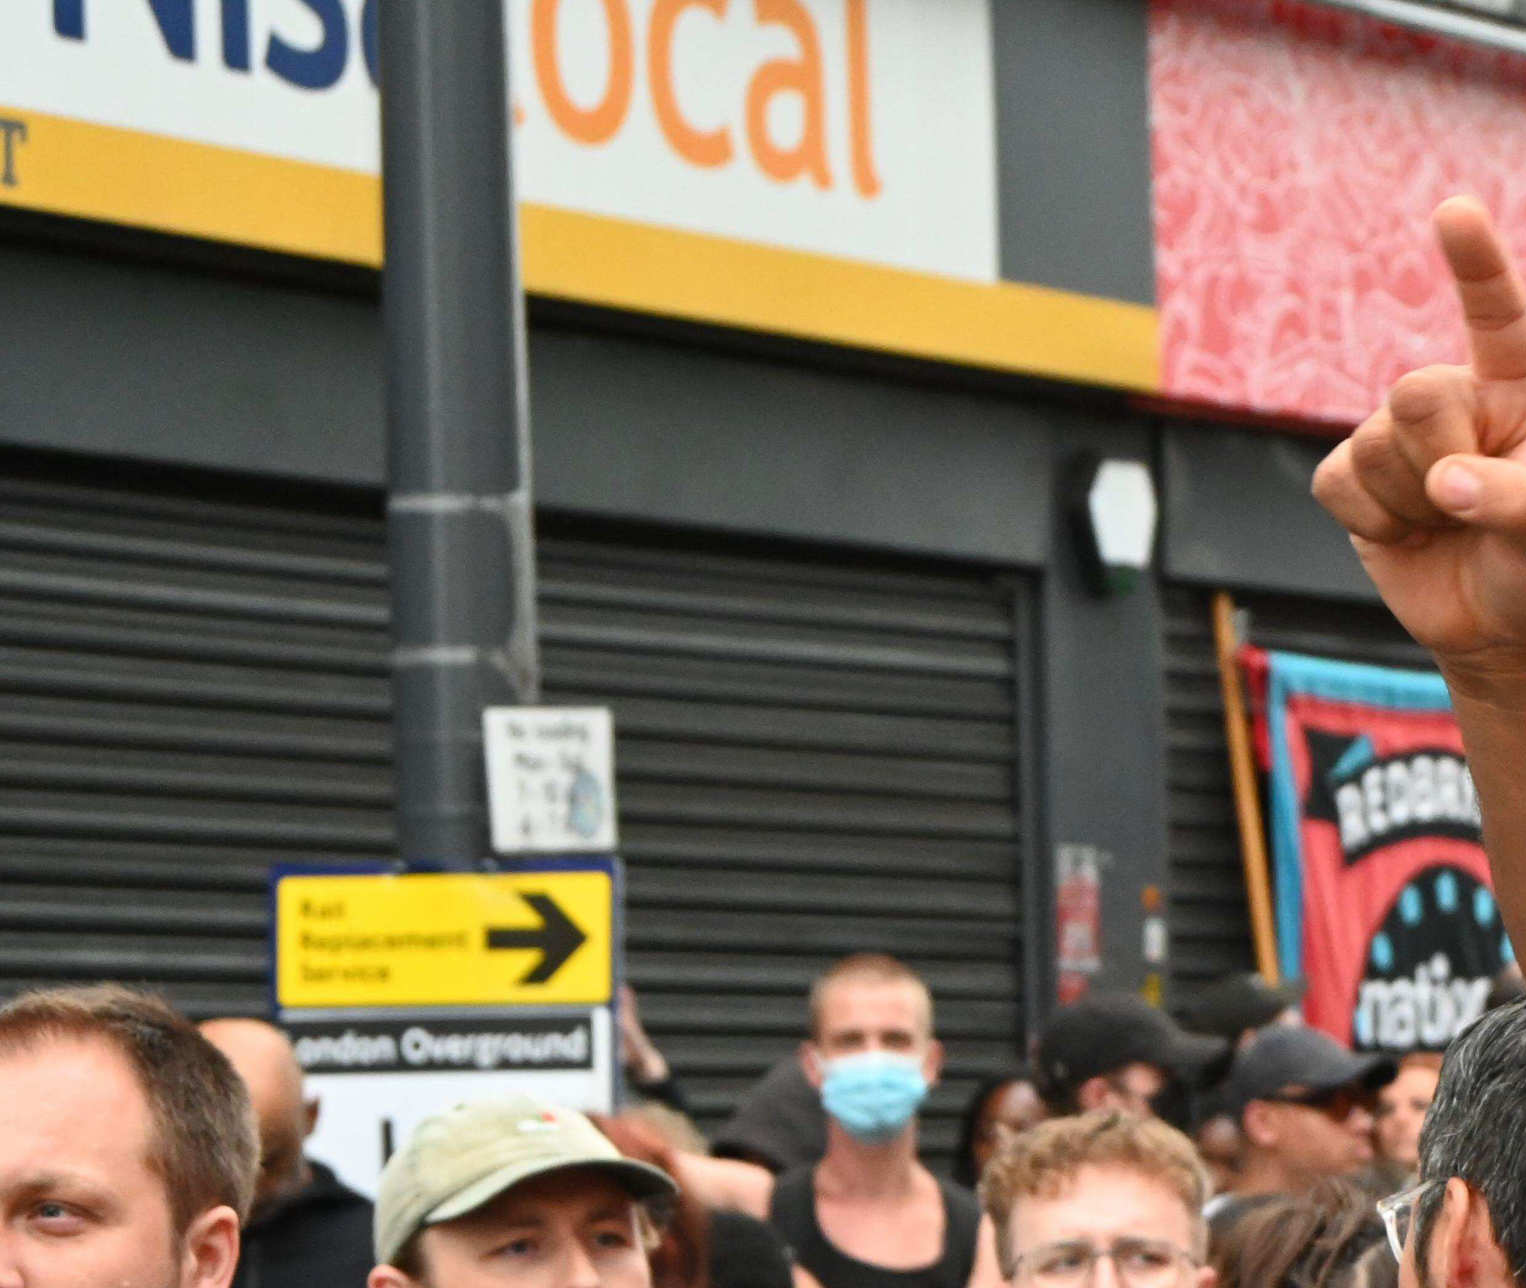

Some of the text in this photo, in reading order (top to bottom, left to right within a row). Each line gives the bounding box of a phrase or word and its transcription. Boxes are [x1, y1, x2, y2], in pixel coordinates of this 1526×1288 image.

[516, 0, 883, 199] ocal
[299, 899, 344, 921] Rail
[300, 929, 469, 954] Replacement
[300, 963, 390, 985] Service
[296, 1024, 588, 1070] ondon Overground
